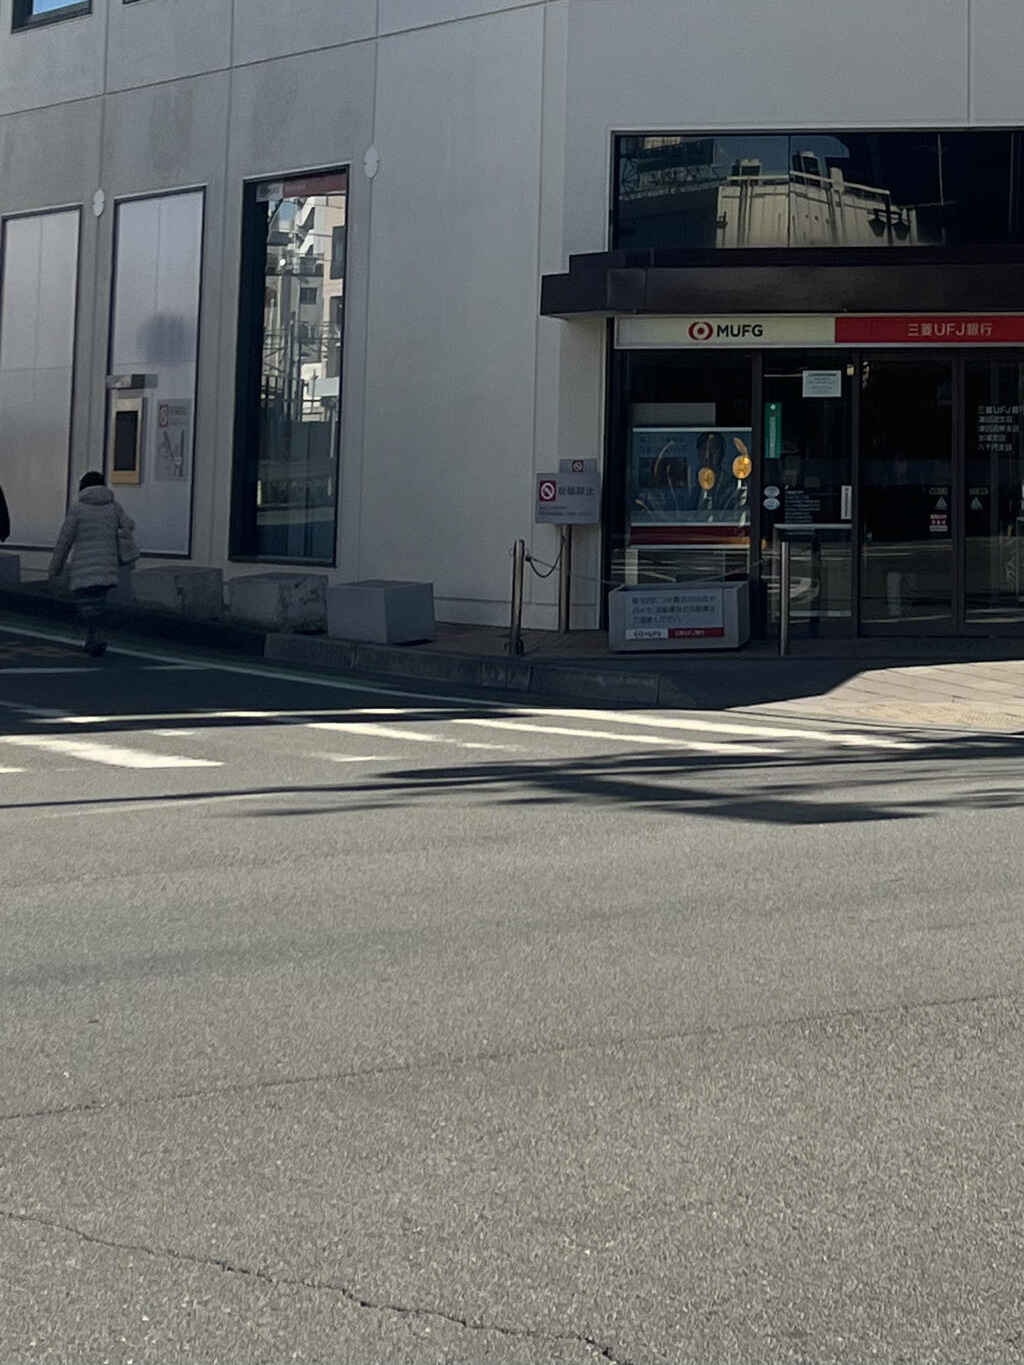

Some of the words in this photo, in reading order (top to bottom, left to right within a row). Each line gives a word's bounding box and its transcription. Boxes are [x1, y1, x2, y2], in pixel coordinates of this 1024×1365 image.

[717, 324, 763, 337] MUFG
[907, 323, 993, 336] 三菱UFJ銀行
